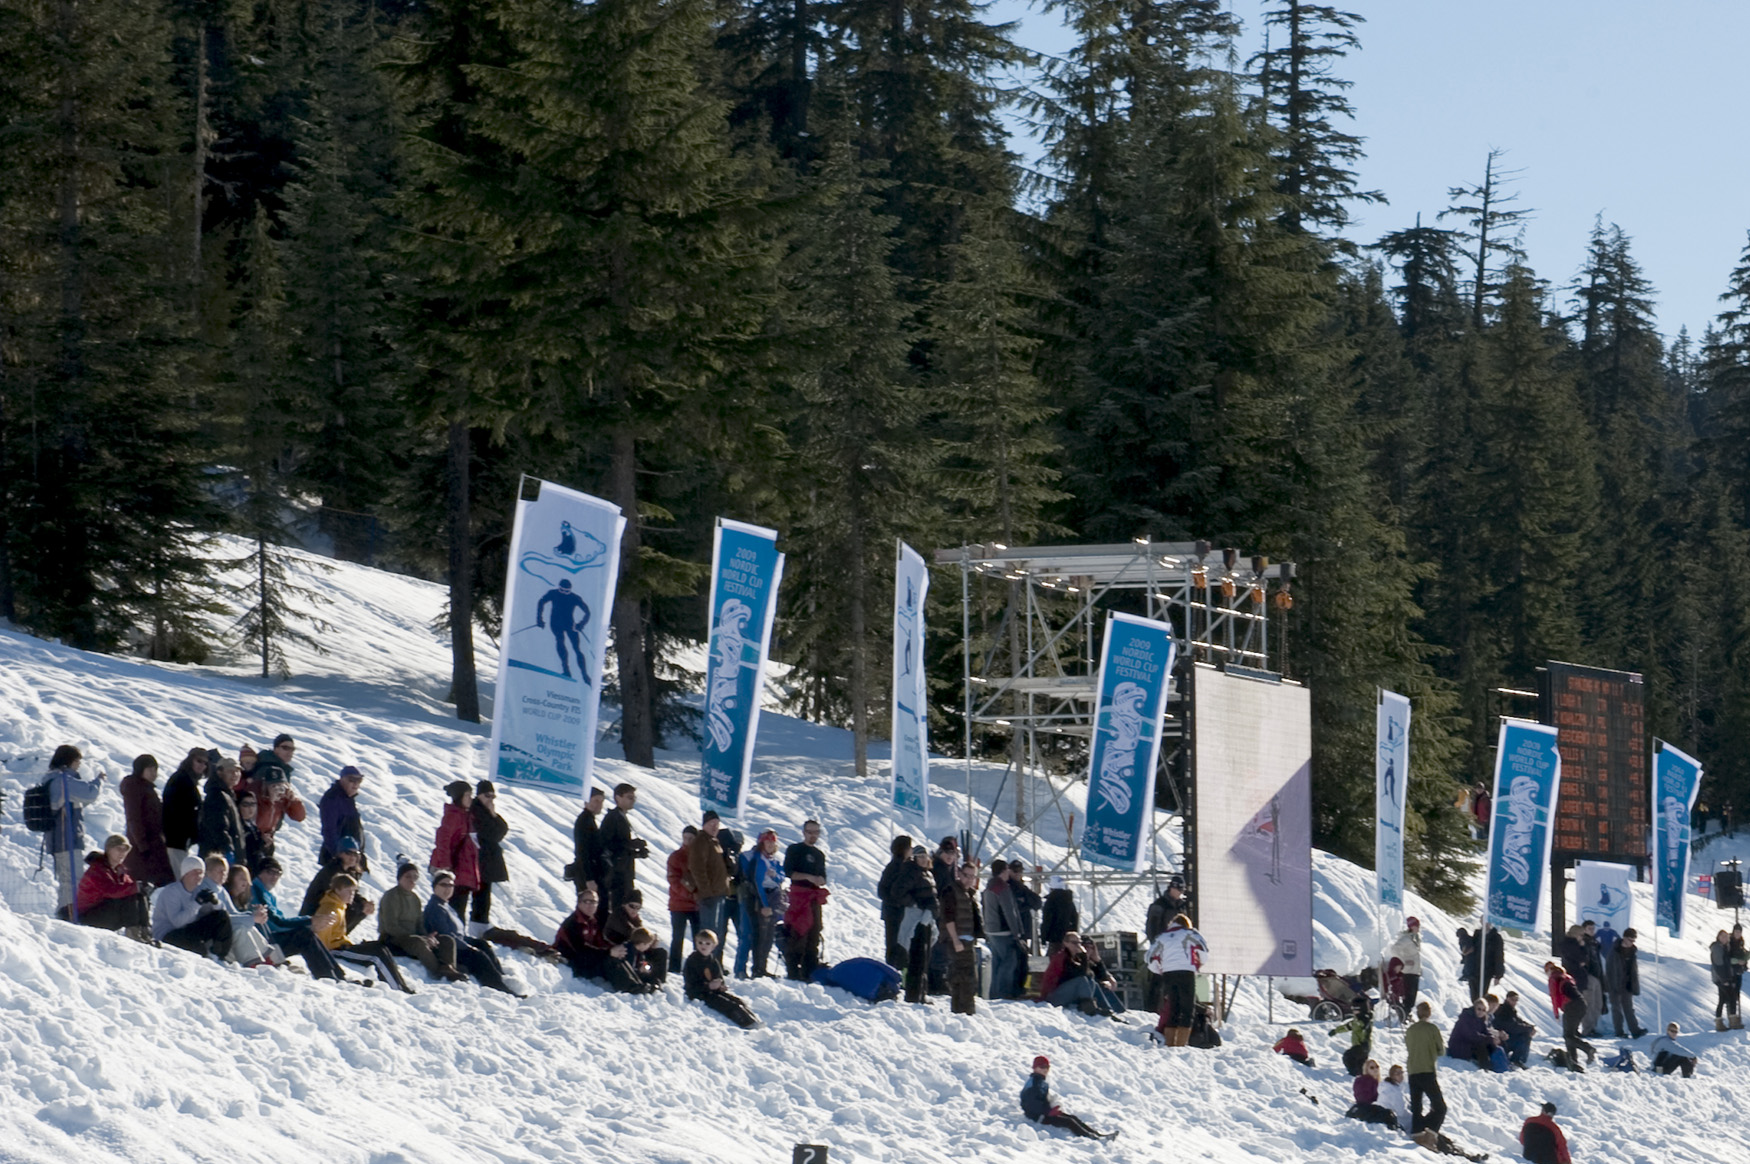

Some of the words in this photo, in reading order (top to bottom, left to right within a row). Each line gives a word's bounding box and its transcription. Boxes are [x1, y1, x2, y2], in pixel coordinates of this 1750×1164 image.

[1129, 637, 1151, 650] 2009
[1122, 646, 1154, 662] NORDIC
[1113, 654, 1142, 669] WORLD
[1143, 662, 1159, 673] CUP
[547, 712, 562, 721] CUP
[536, 733, 577, 750] Whistler
[537, 744, 575, 760] Olympic
[552, 758, 573, 772] Park
